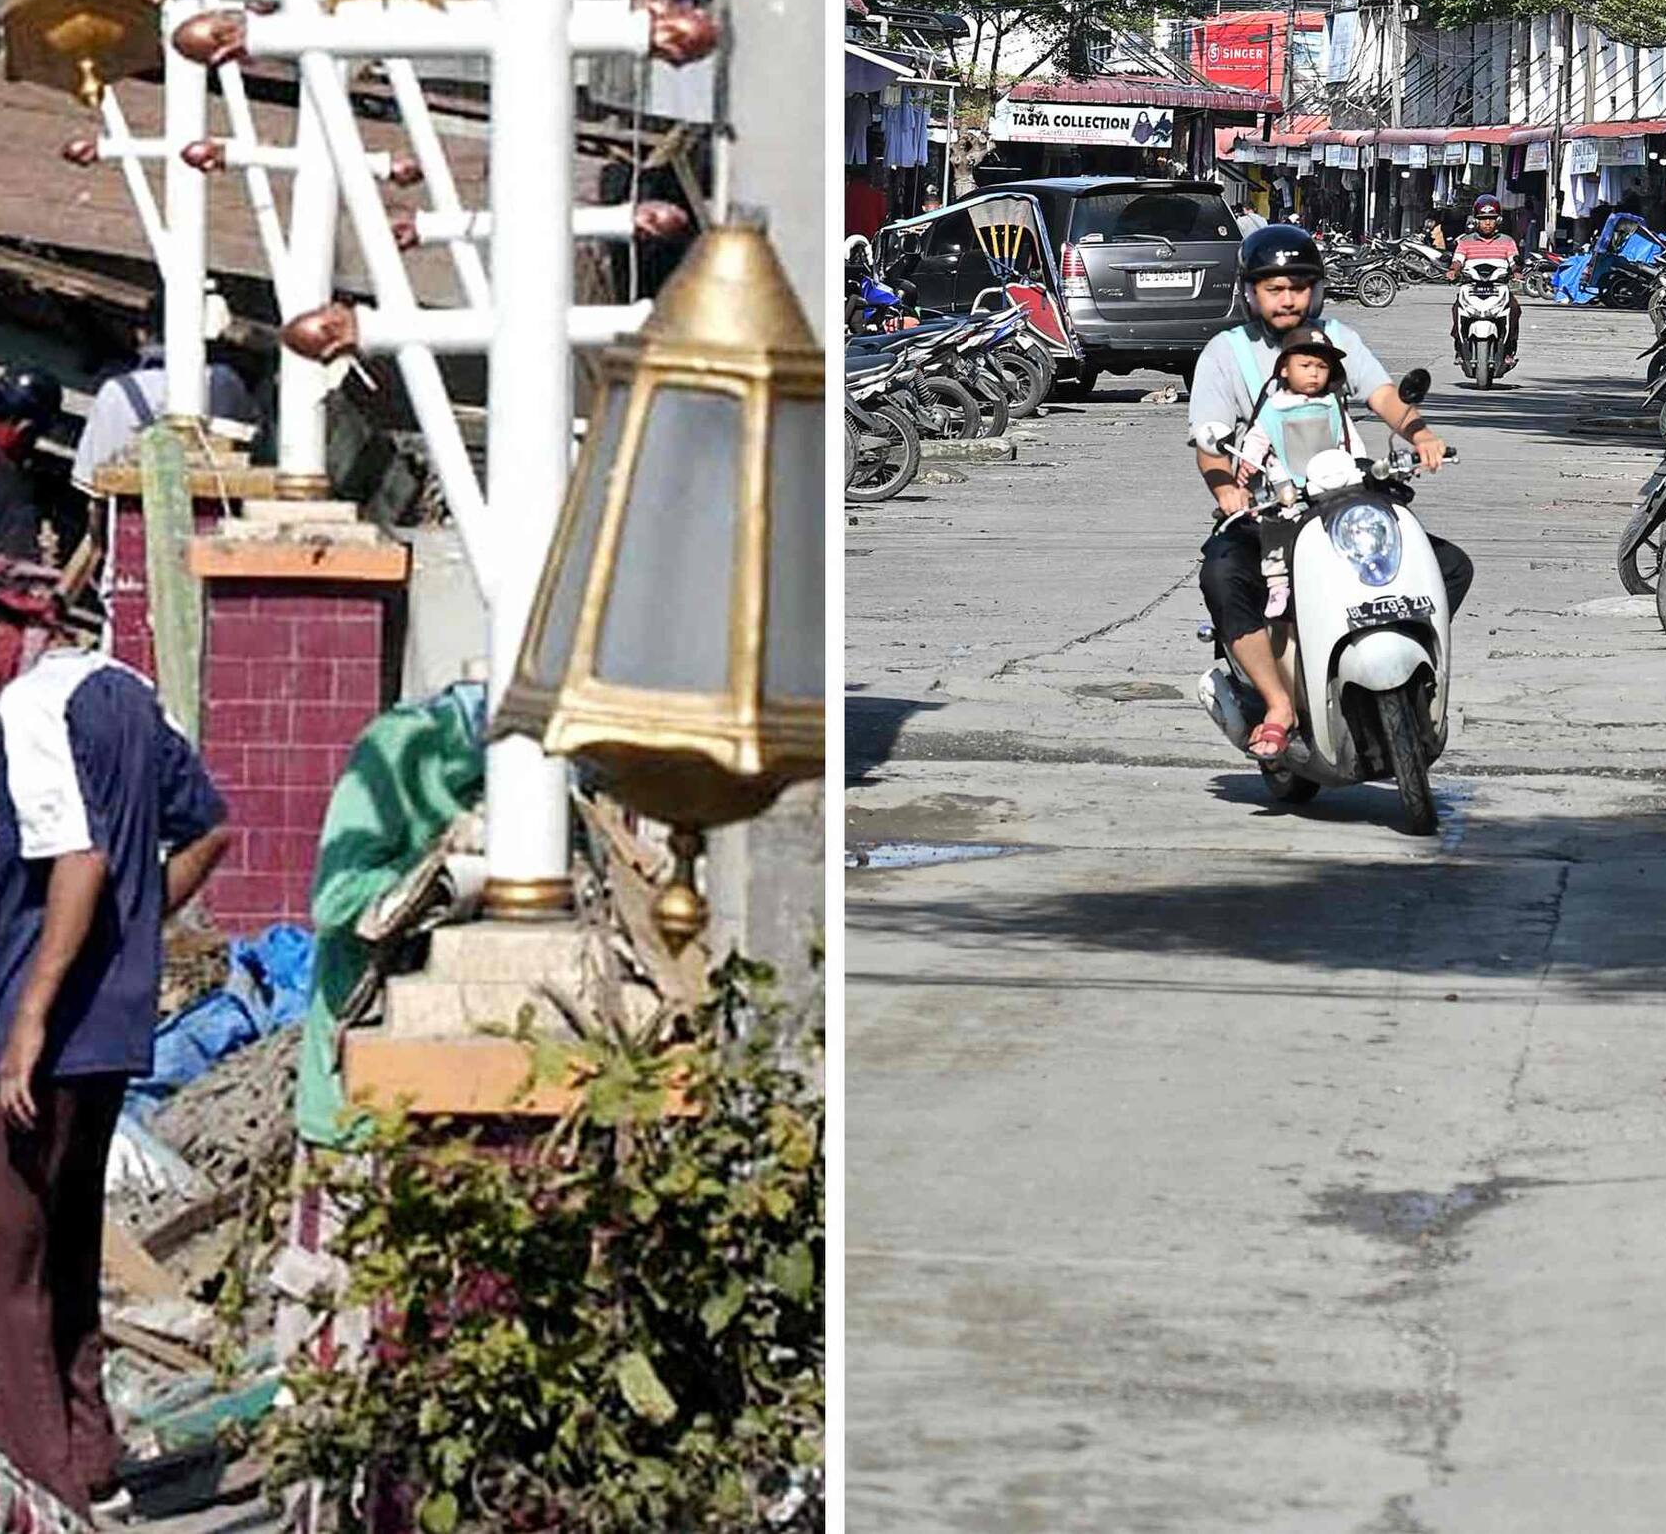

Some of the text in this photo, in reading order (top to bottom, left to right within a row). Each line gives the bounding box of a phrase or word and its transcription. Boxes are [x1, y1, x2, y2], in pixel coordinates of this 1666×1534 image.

[1222, 48, 1263, 59] SINGER
[1012, 113, 1130, 130] TASYA COLLECTION
[1348, 606, 1369, 619] BL
[1372, 598, 1408, 615] 4495
